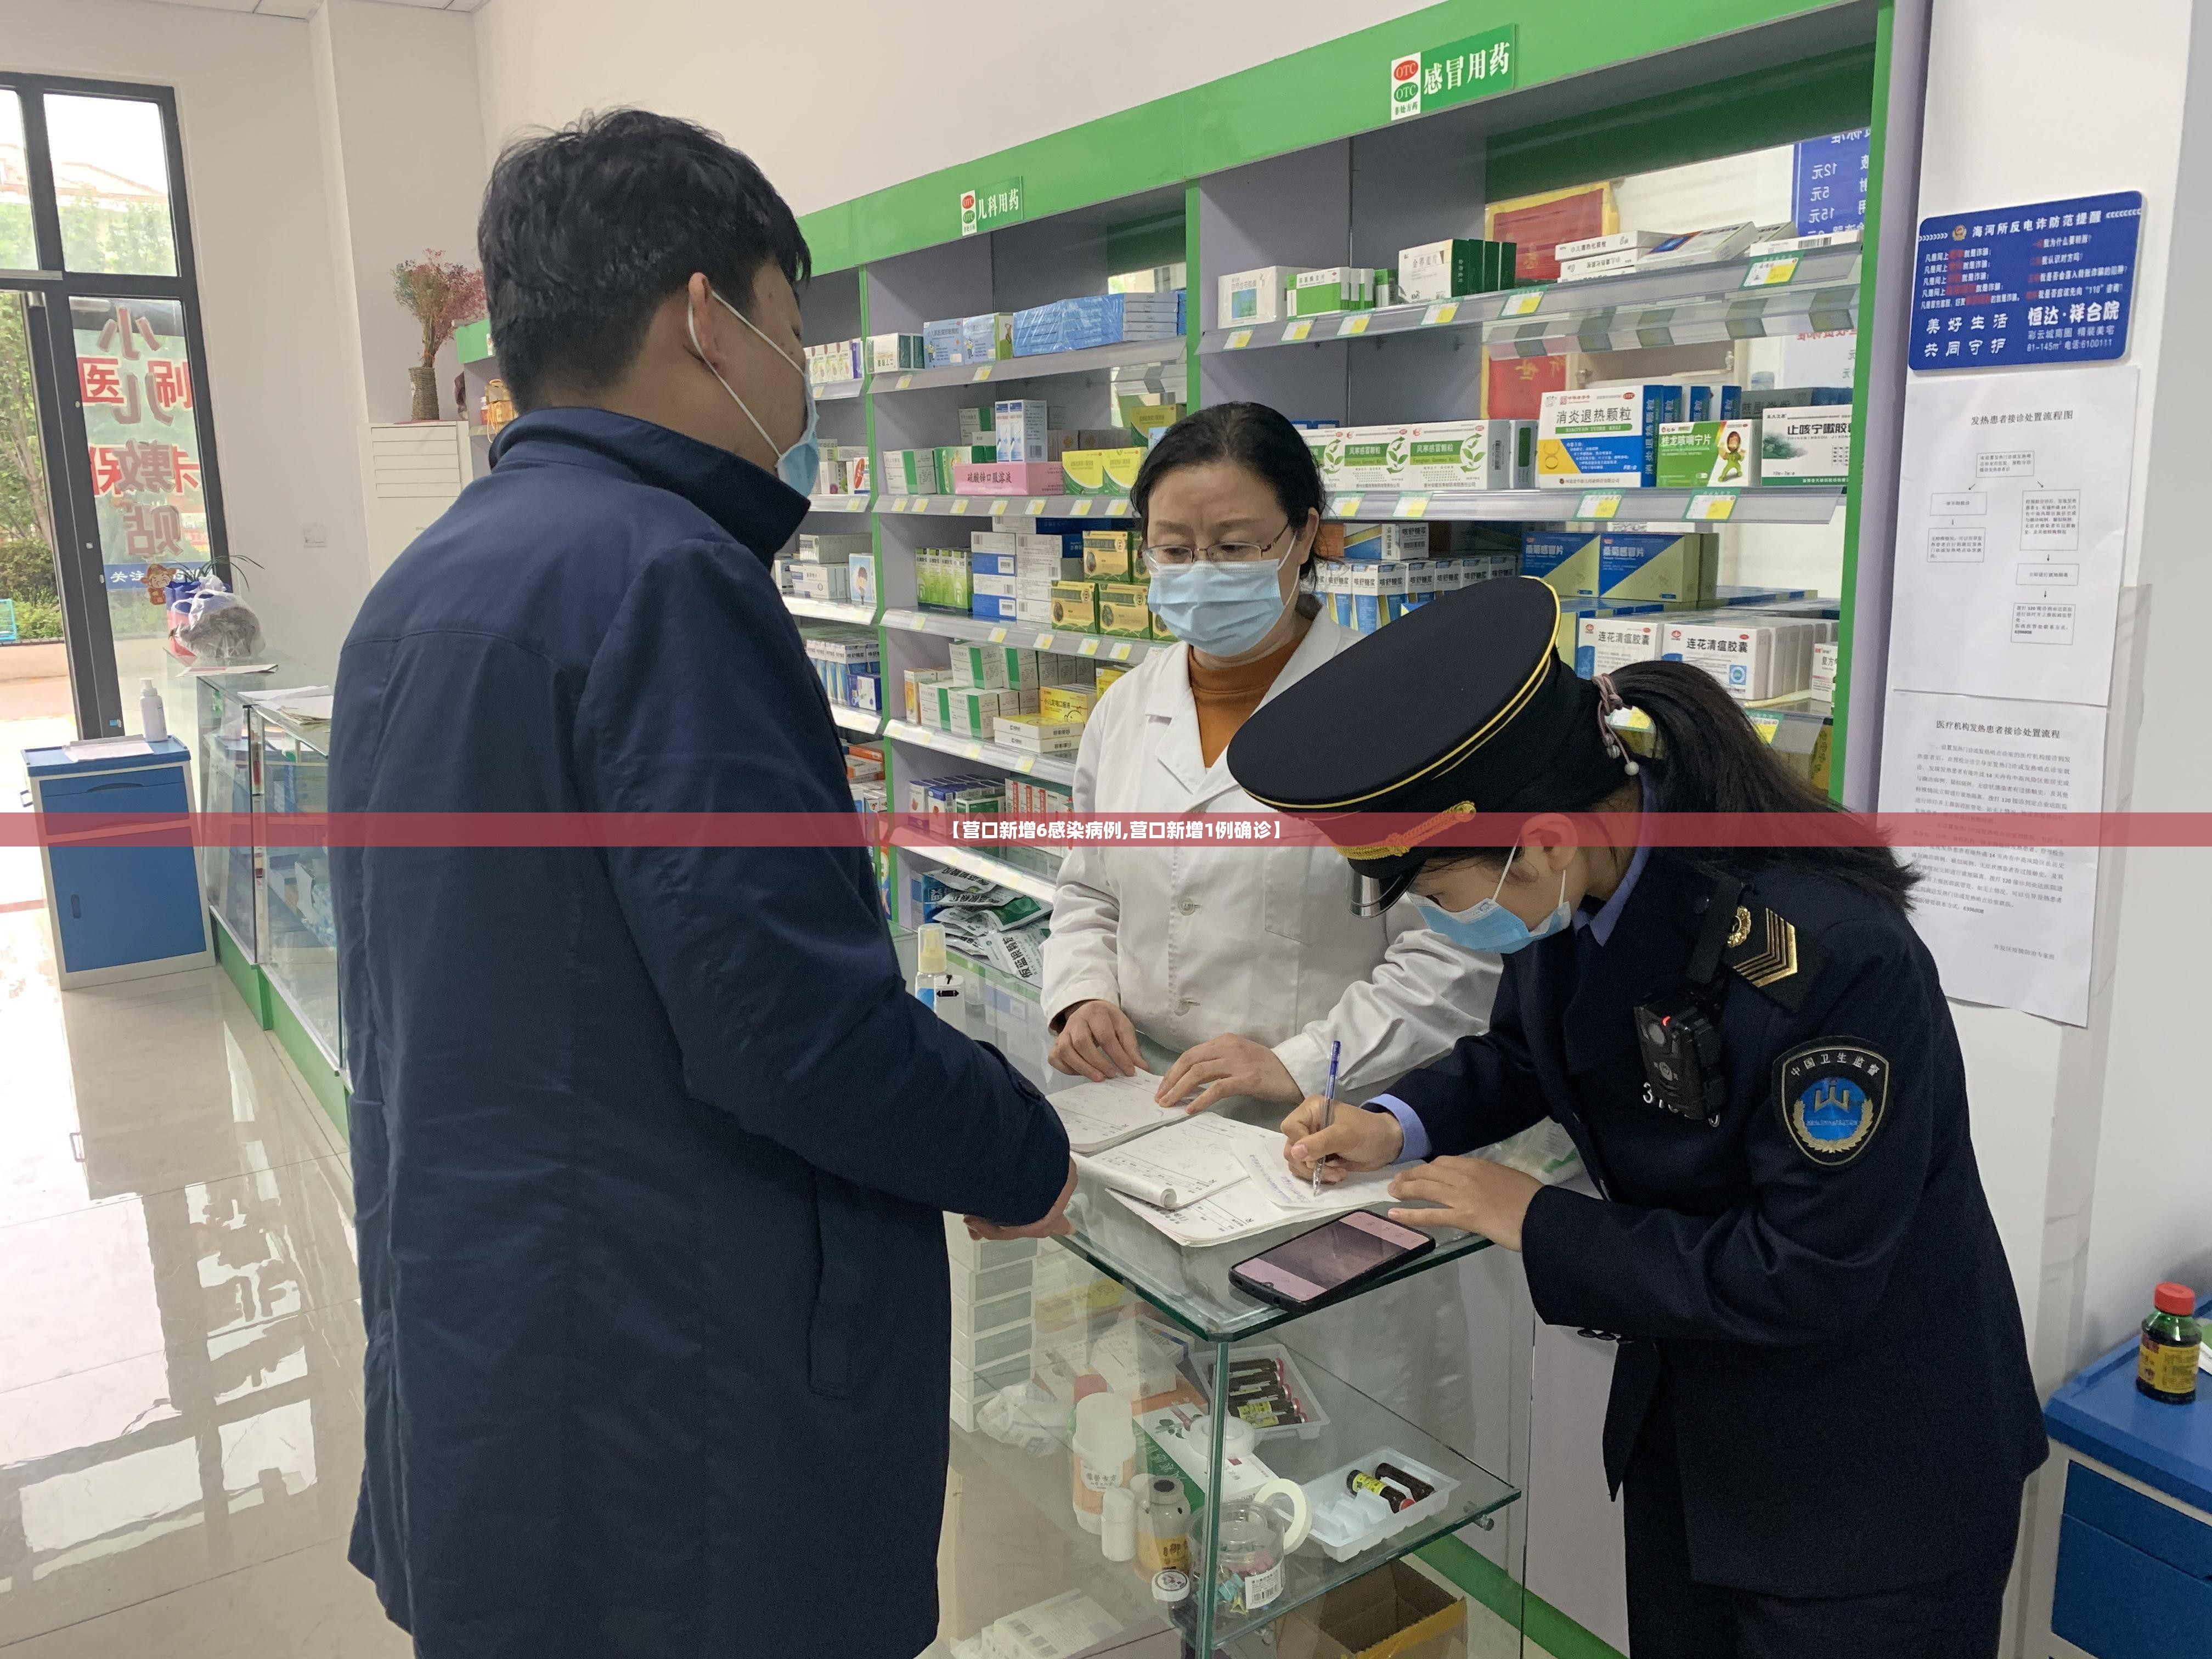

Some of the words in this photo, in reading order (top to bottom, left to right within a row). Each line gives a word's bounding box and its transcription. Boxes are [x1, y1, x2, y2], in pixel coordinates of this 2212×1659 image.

[1396, 63, 1417, 78] OTC
[1424, 42, 1510, 94] 感冒用药
[1396, 84, 1417, 100] OTC
[978, 188, 1019, 220] 儿科用药
[1972, 211, 2101, 238] 海河所反电诈防范提醒
[1927, 313, 2008, 334] 美好生活
[1925, 338, 2006, 357] 共同守护
[1556, 407, 1632, 424] 消炎退热颗粒
[1971, 410, 2073, 425] 发热患者接诊处置流程图
[1787, 424, 1850, 435] 止咳宁嗽胶
[967, 472, 1012, 483] 硫酸锌口服溶液
[1598, 631, 1650, 645] 连花清瘟胶囊
[1686, 637, 1748, 653] 连花清瘟胶囊
[1937, 720, 2059, 738] 医疗机构发热患者接诊处置流程
[1002, 936, 1033, 978] 板蓝根颗粒
[1791, 1052, 1881, 1077] 中国卫生监督
